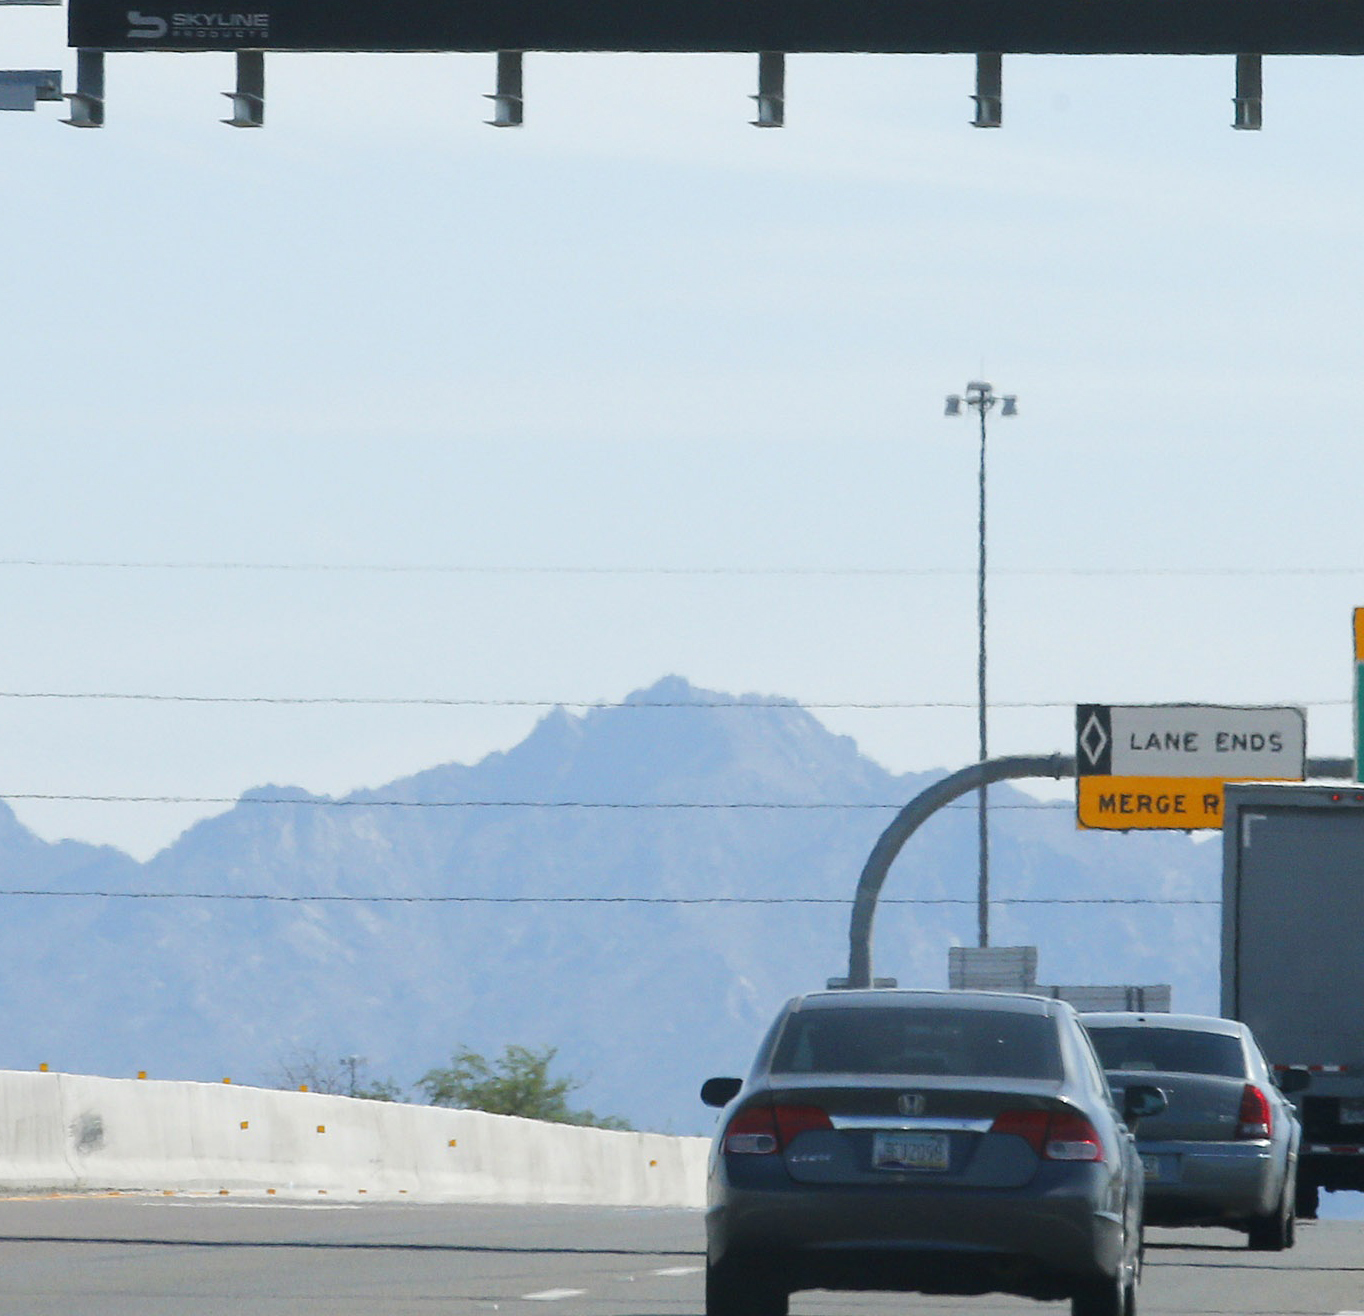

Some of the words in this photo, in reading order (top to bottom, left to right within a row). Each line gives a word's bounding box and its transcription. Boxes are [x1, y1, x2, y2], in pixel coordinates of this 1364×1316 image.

[172, 13, 269, 26] SKYLINE
[1130, 732, 1199, 751] LANE
[1216, 732, 1284, 752] ENDS
[1098, 794, 1187, 815] MERGE
[1203, 794, 1219, 815] R
